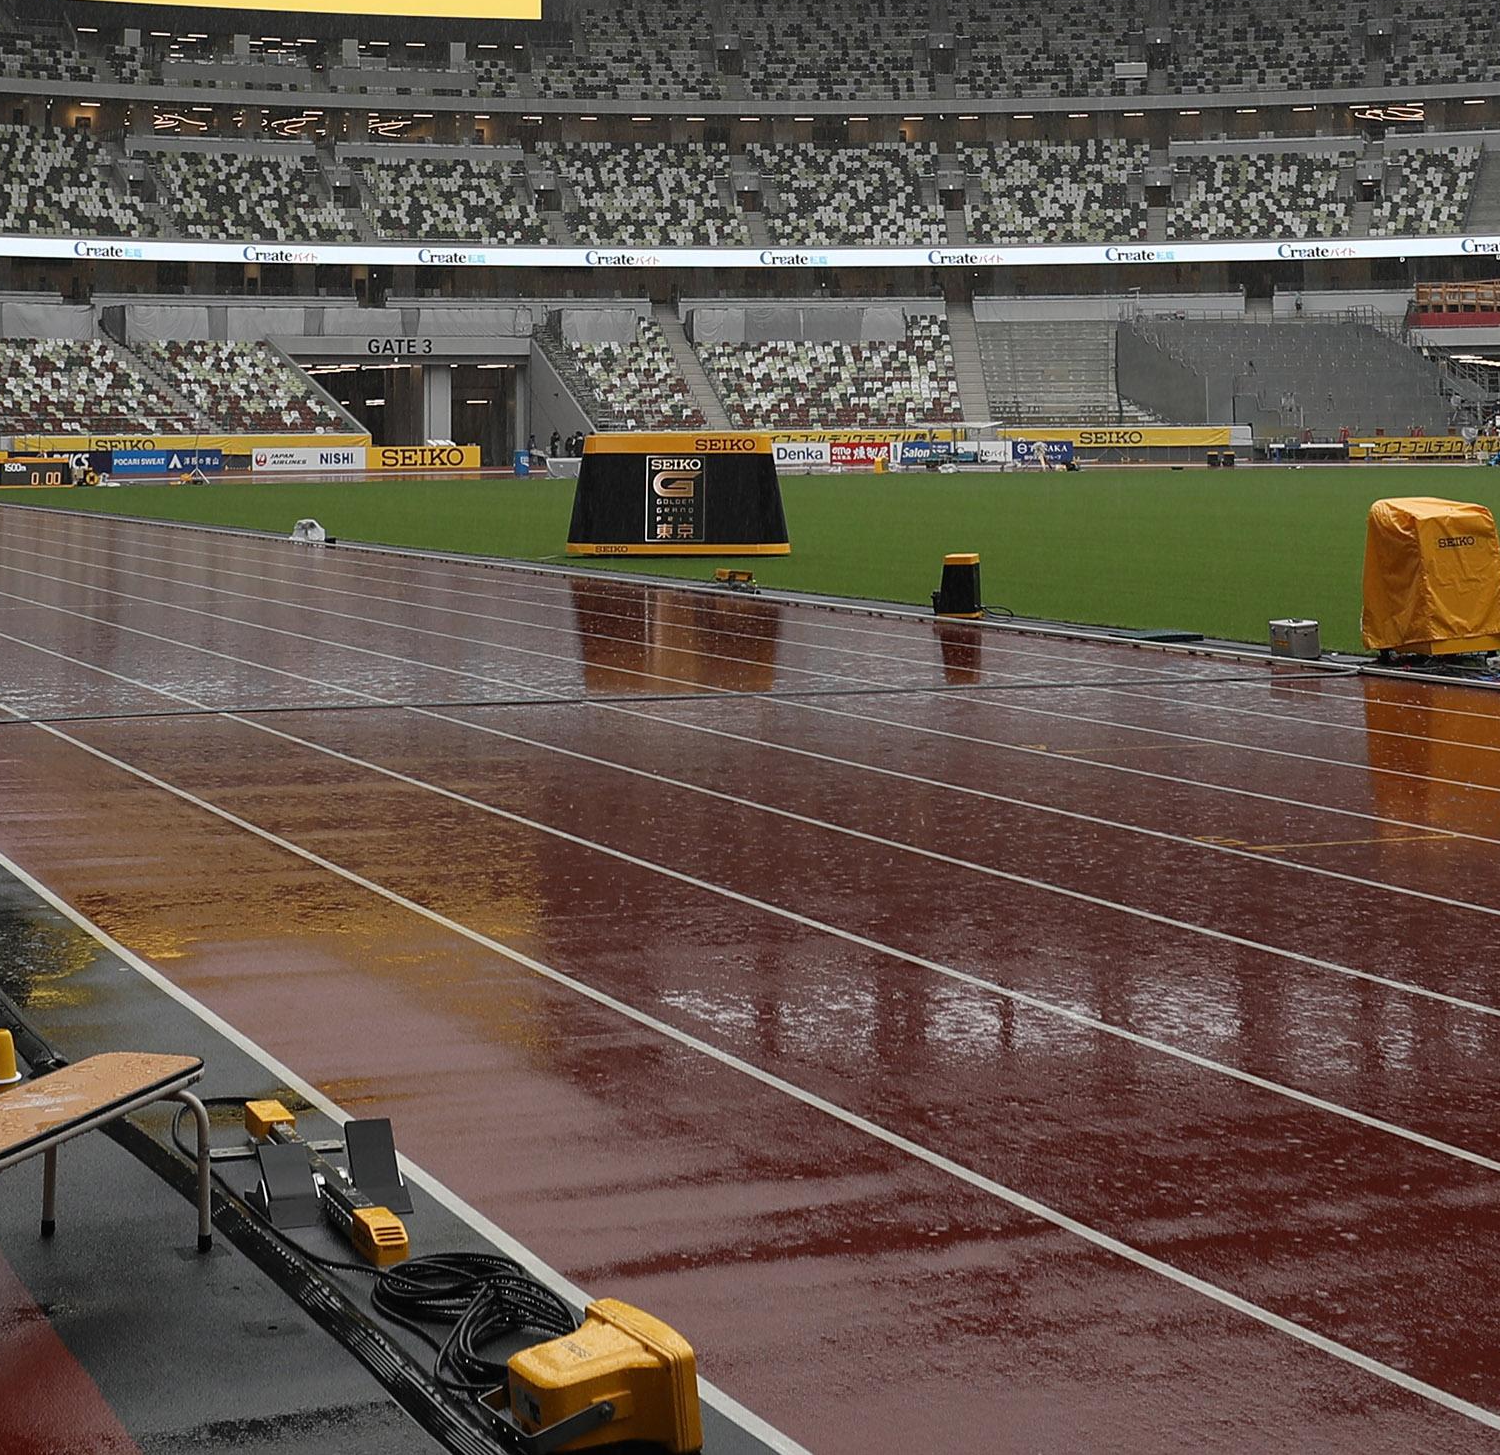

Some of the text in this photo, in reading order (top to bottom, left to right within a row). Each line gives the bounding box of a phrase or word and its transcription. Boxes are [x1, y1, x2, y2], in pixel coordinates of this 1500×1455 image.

[368, 339, 432, 354] GATE 3
[95, 438, 156, 450] SEIKO
[695, 438, 756, 451] SEIKO
[1079, 431, 1143, 445] SEIKO
[319, 452, 355, 465] NISHI
[381, 448, 464, 466] SEIKO
[776, 447, 824, 460] Denka
[4, 463, 27, 472] 1500m
[113, 458, 165, 466] POCARI SWEAT
[651, 459, 701, 470] SEIKO
[656, 524, 694, 539] 東京
[1438, 536, 1475, 548] SEIKO
